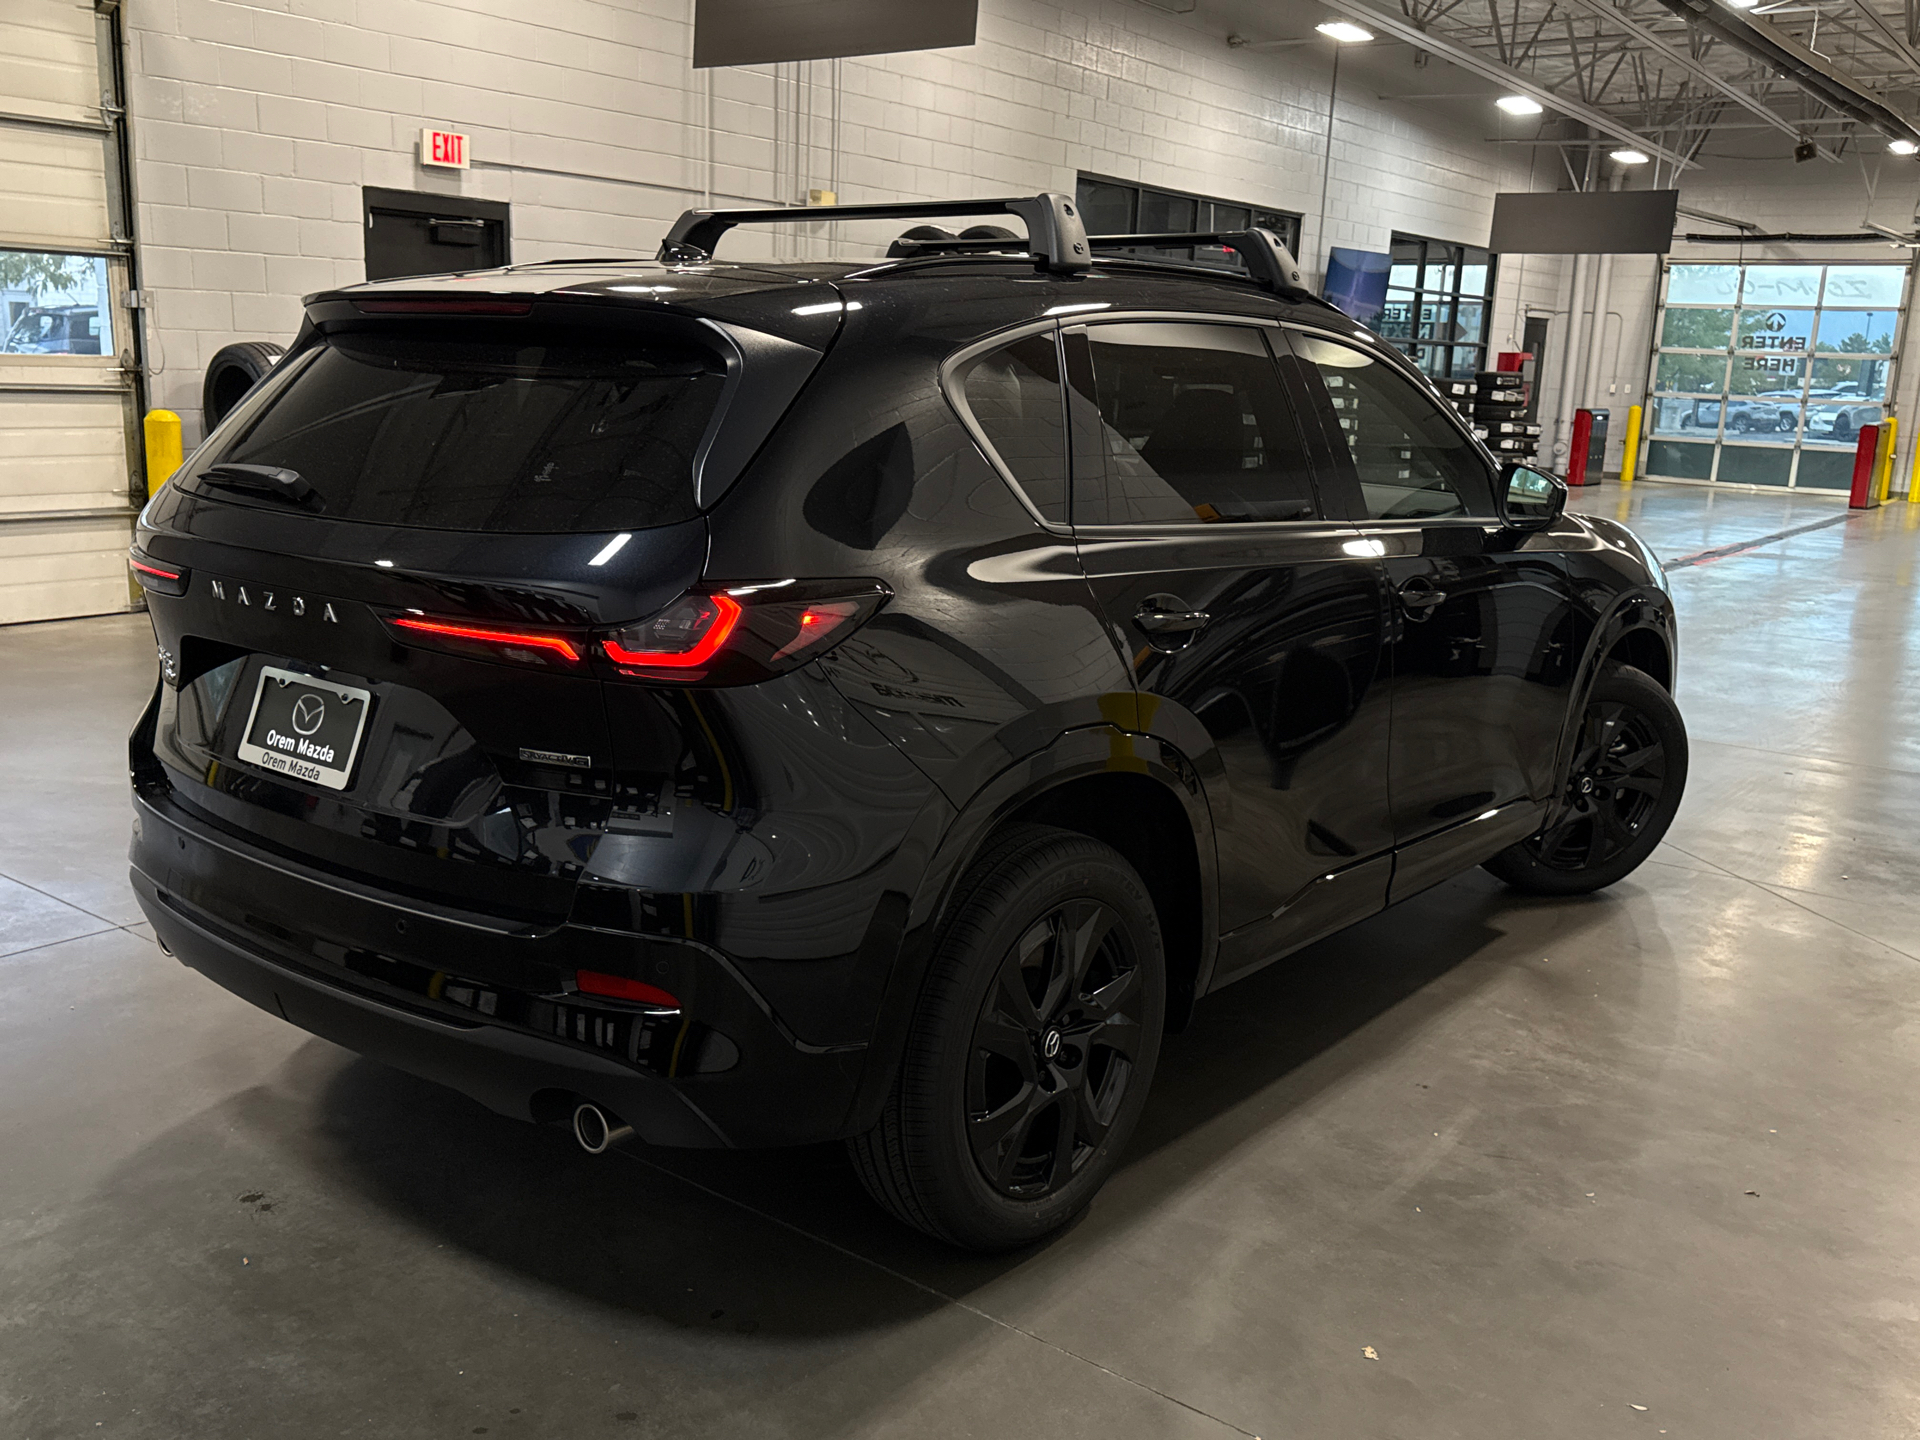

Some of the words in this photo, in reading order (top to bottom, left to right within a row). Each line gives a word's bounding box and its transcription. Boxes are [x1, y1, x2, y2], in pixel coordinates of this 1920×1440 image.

[432, 132, 463, 165] EXIT
[211, 580, 338, 624] MAZDA
[266, 729, 296, 752] Orem
[296, 738, 335, 763] Mazda
[261, 751, 287, 770] Orem
[287, 760, 321, 781] Mazda
